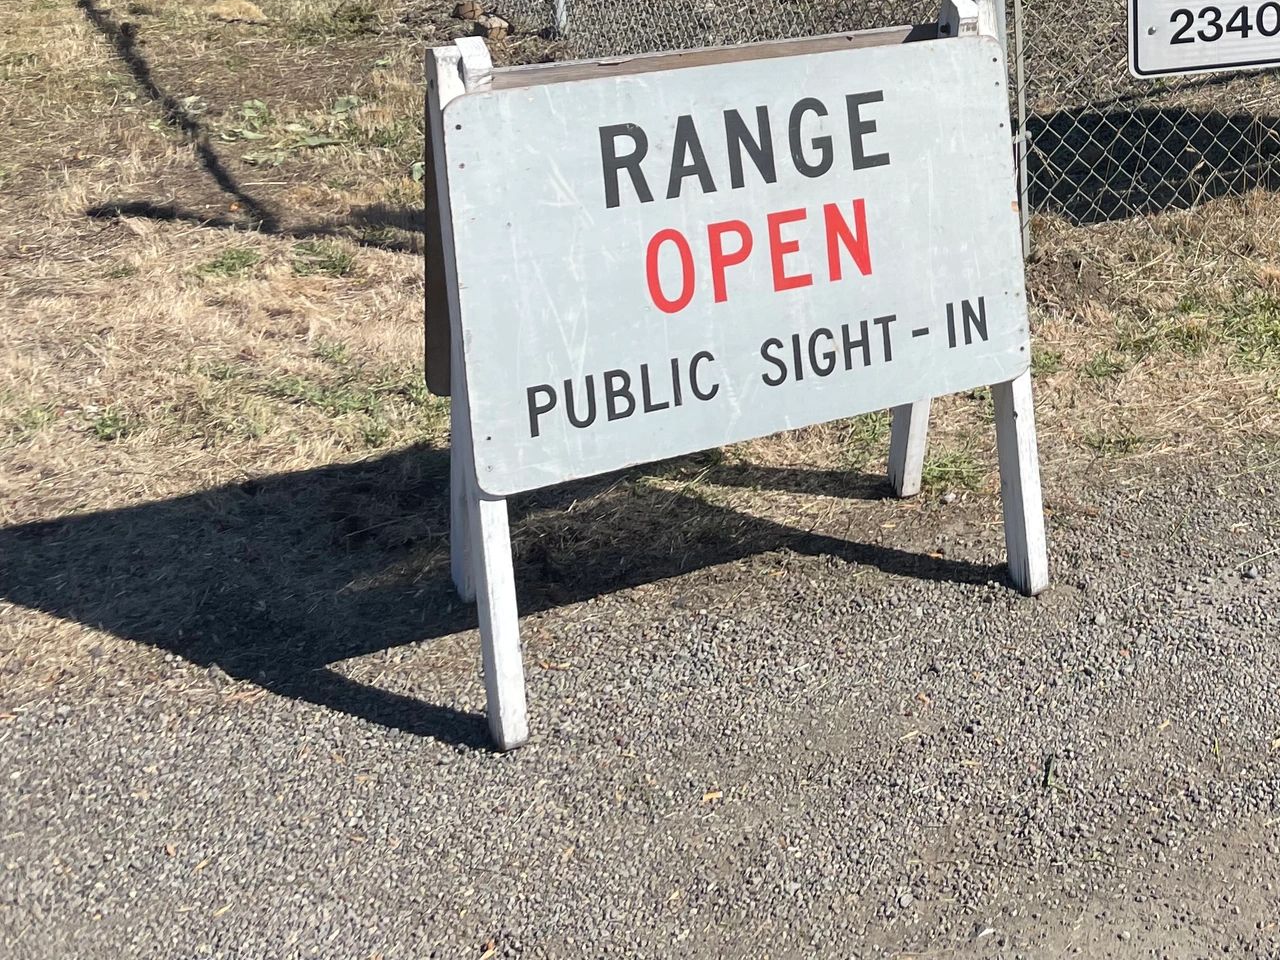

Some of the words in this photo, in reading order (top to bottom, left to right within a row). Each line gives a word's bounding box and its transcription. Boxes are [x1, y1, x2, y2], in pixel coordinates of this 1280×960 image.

[598, 90, 891, 209] RANGE
[645, 198, 873, 314] OPEN
[526, 350, 720, 438] PUBLIC
